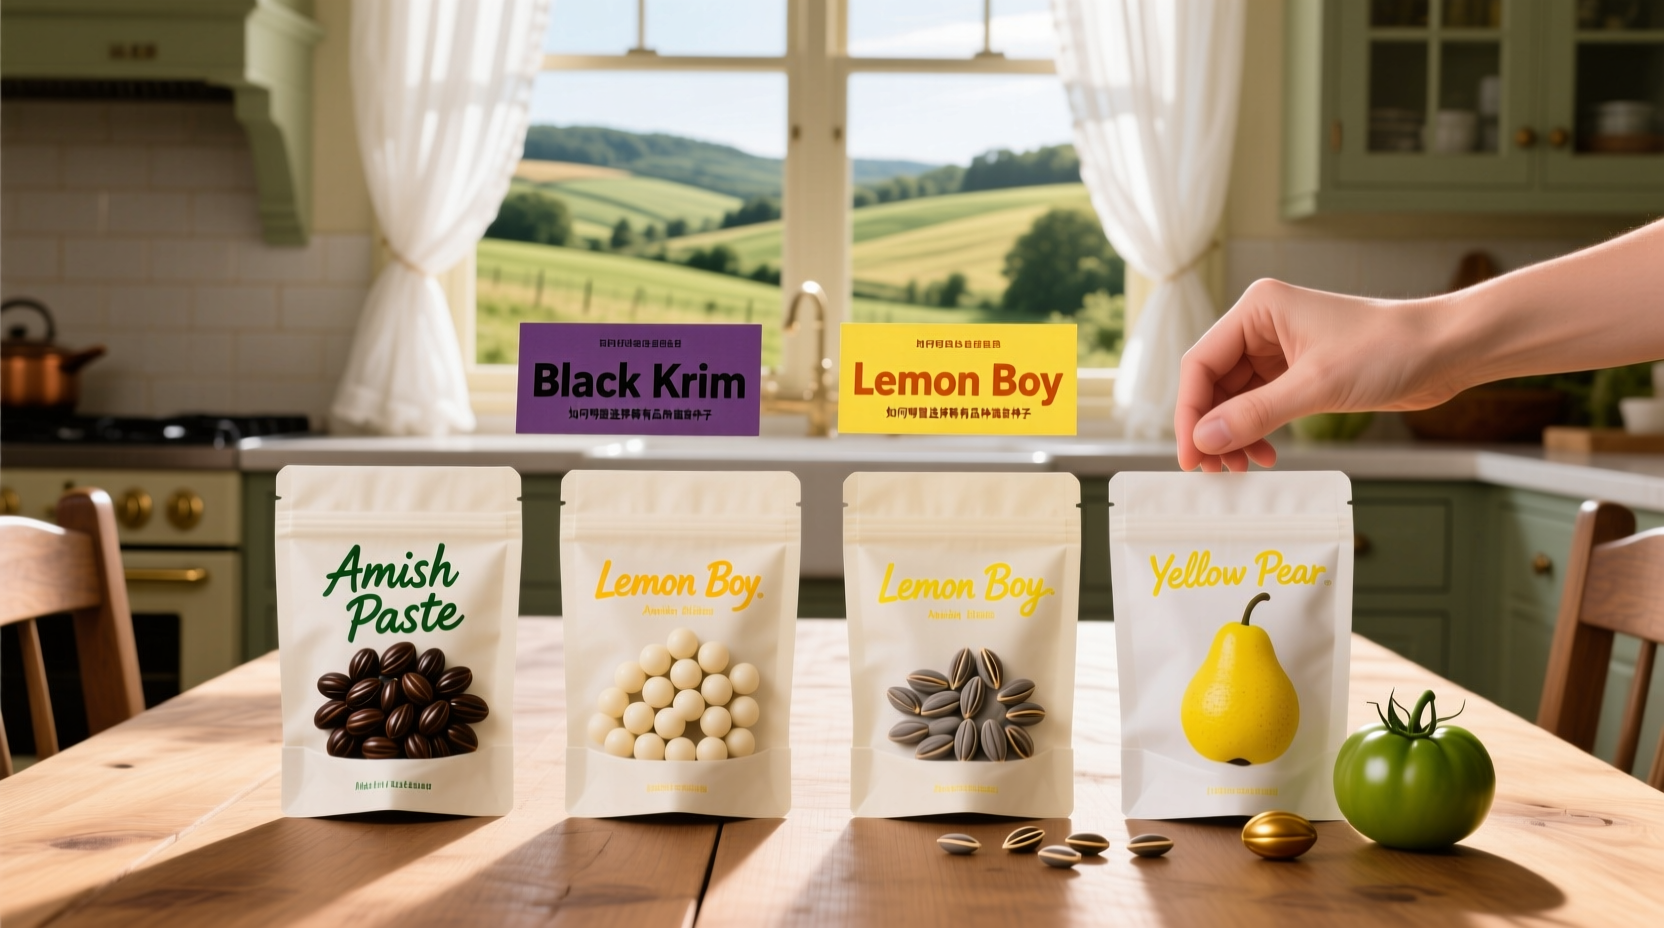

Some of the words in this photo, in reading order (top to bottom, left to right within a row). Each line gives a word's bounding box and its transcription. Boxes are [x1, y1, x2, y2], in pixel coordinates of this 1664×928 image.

[533, 362, 641, 398] Black
[653, 362, 746, 399] Krim
[854, 361, 980, 397] Lemon
[992, 362, 1064, 406] Boy
[322, 542, 460, 597] Amish
[594, 559, 697, 600] Lemon
[878, 562, 976, 604] Lemon
[1149, 549, 1247, 597] Yellow
[346, 592, 465, 644] Paste
